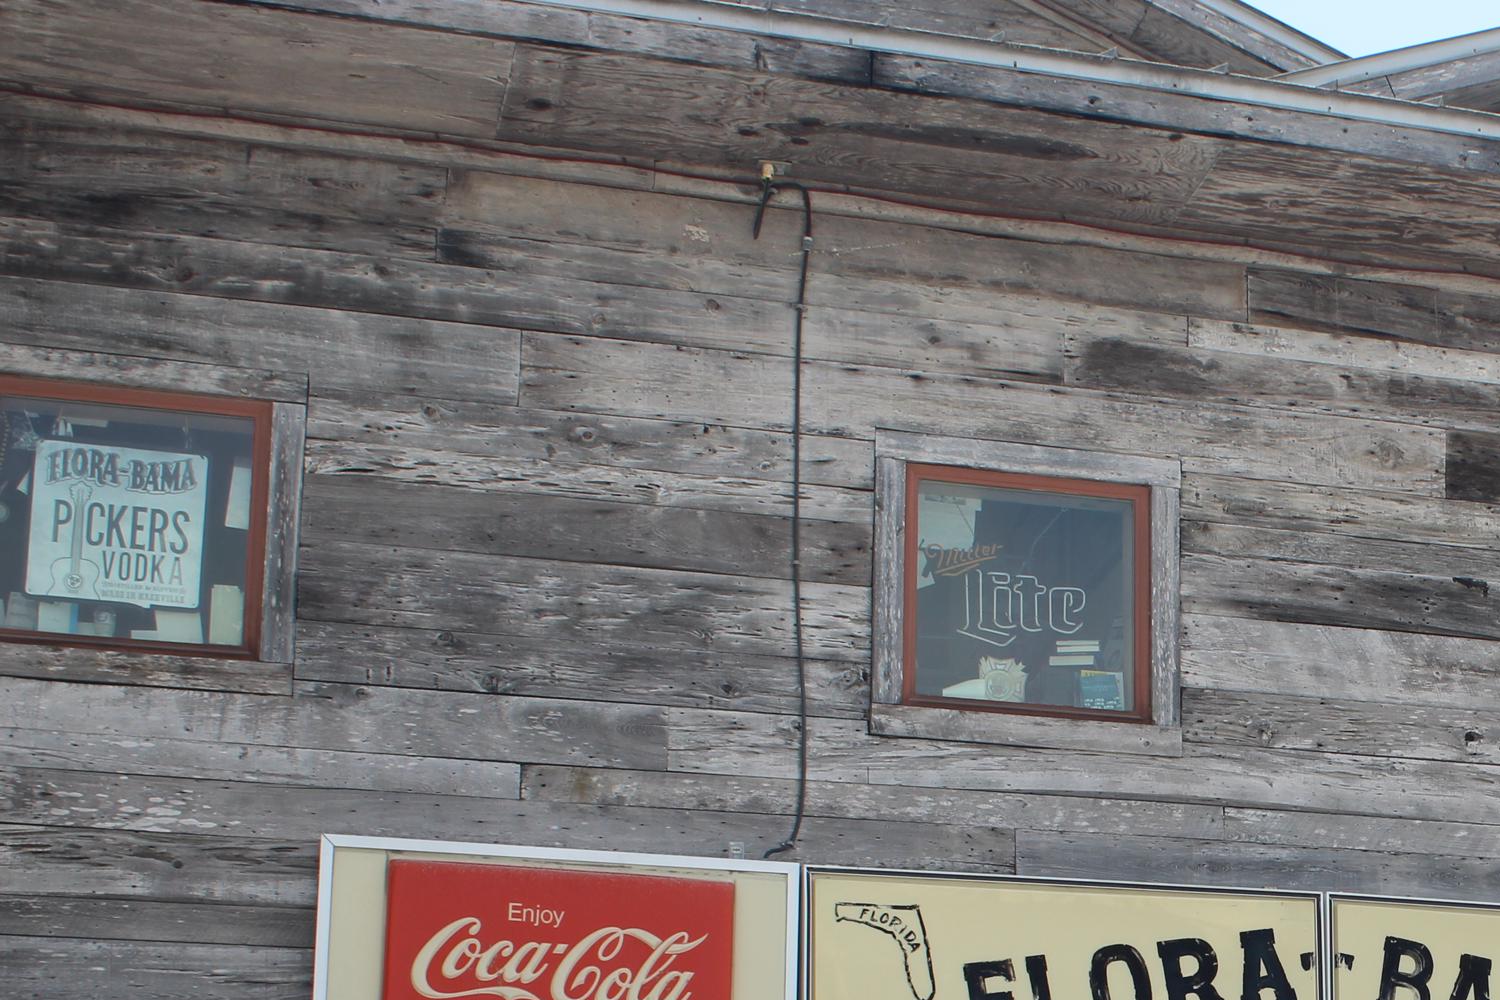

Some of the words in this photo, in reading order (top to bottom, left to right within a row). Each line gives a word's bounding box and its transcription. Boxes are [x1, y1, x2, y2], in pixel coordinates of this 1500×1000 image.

[45, 447, 197, 496] FLORA-BAMA
[101, 550, 184, 586] VODKA
[925, 543, 1004, 570] Miller
[956, 568, 1086, 647] Lite
[507, 902, 565, 928] Enjoy
[859, 907, 921, 953] FLORIDA
